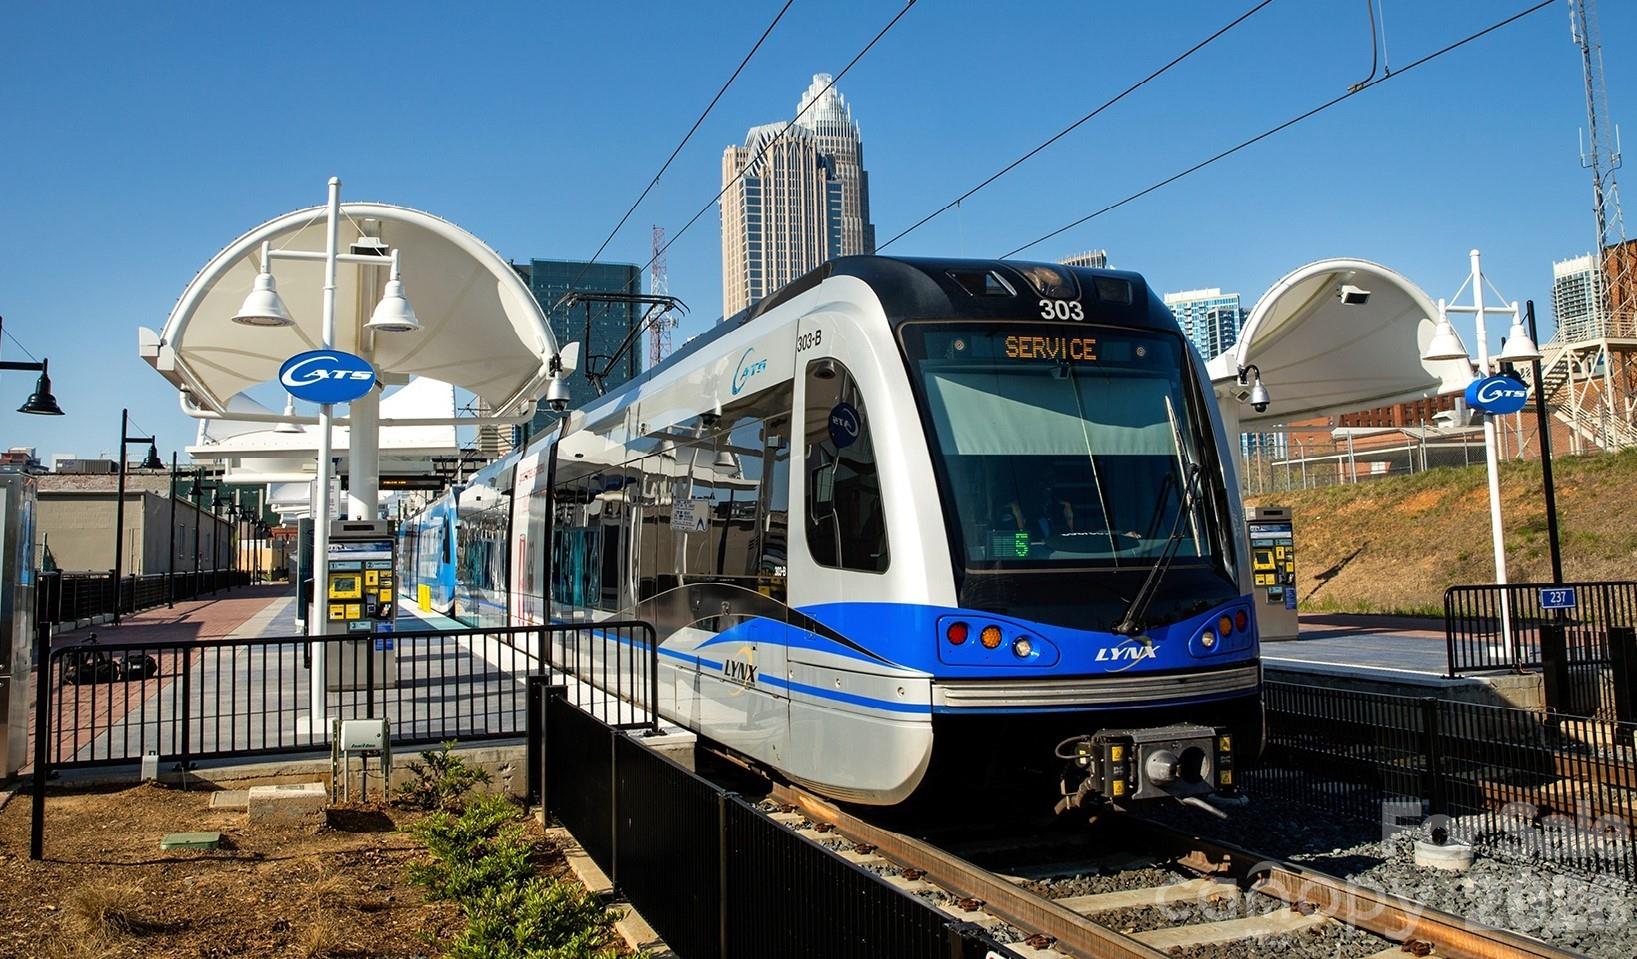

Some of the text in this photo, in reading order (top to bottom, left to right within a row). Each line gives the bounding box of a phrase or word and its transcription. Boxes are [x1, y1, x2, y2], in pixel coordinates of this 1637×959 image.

[1039, 299, 1084, 321] 303
[797, 329, 822, 352] 303-B
[1005, 335, 1097, 360] SERVICE
[281, 356, 374, 387] CATS
[1477, 379, 1526, 403] CATS
[1550, 591, 1566, 603] 237
[1094, 644, 1161, 662] LYNX
[724, 659, 758, 684] LYNX
